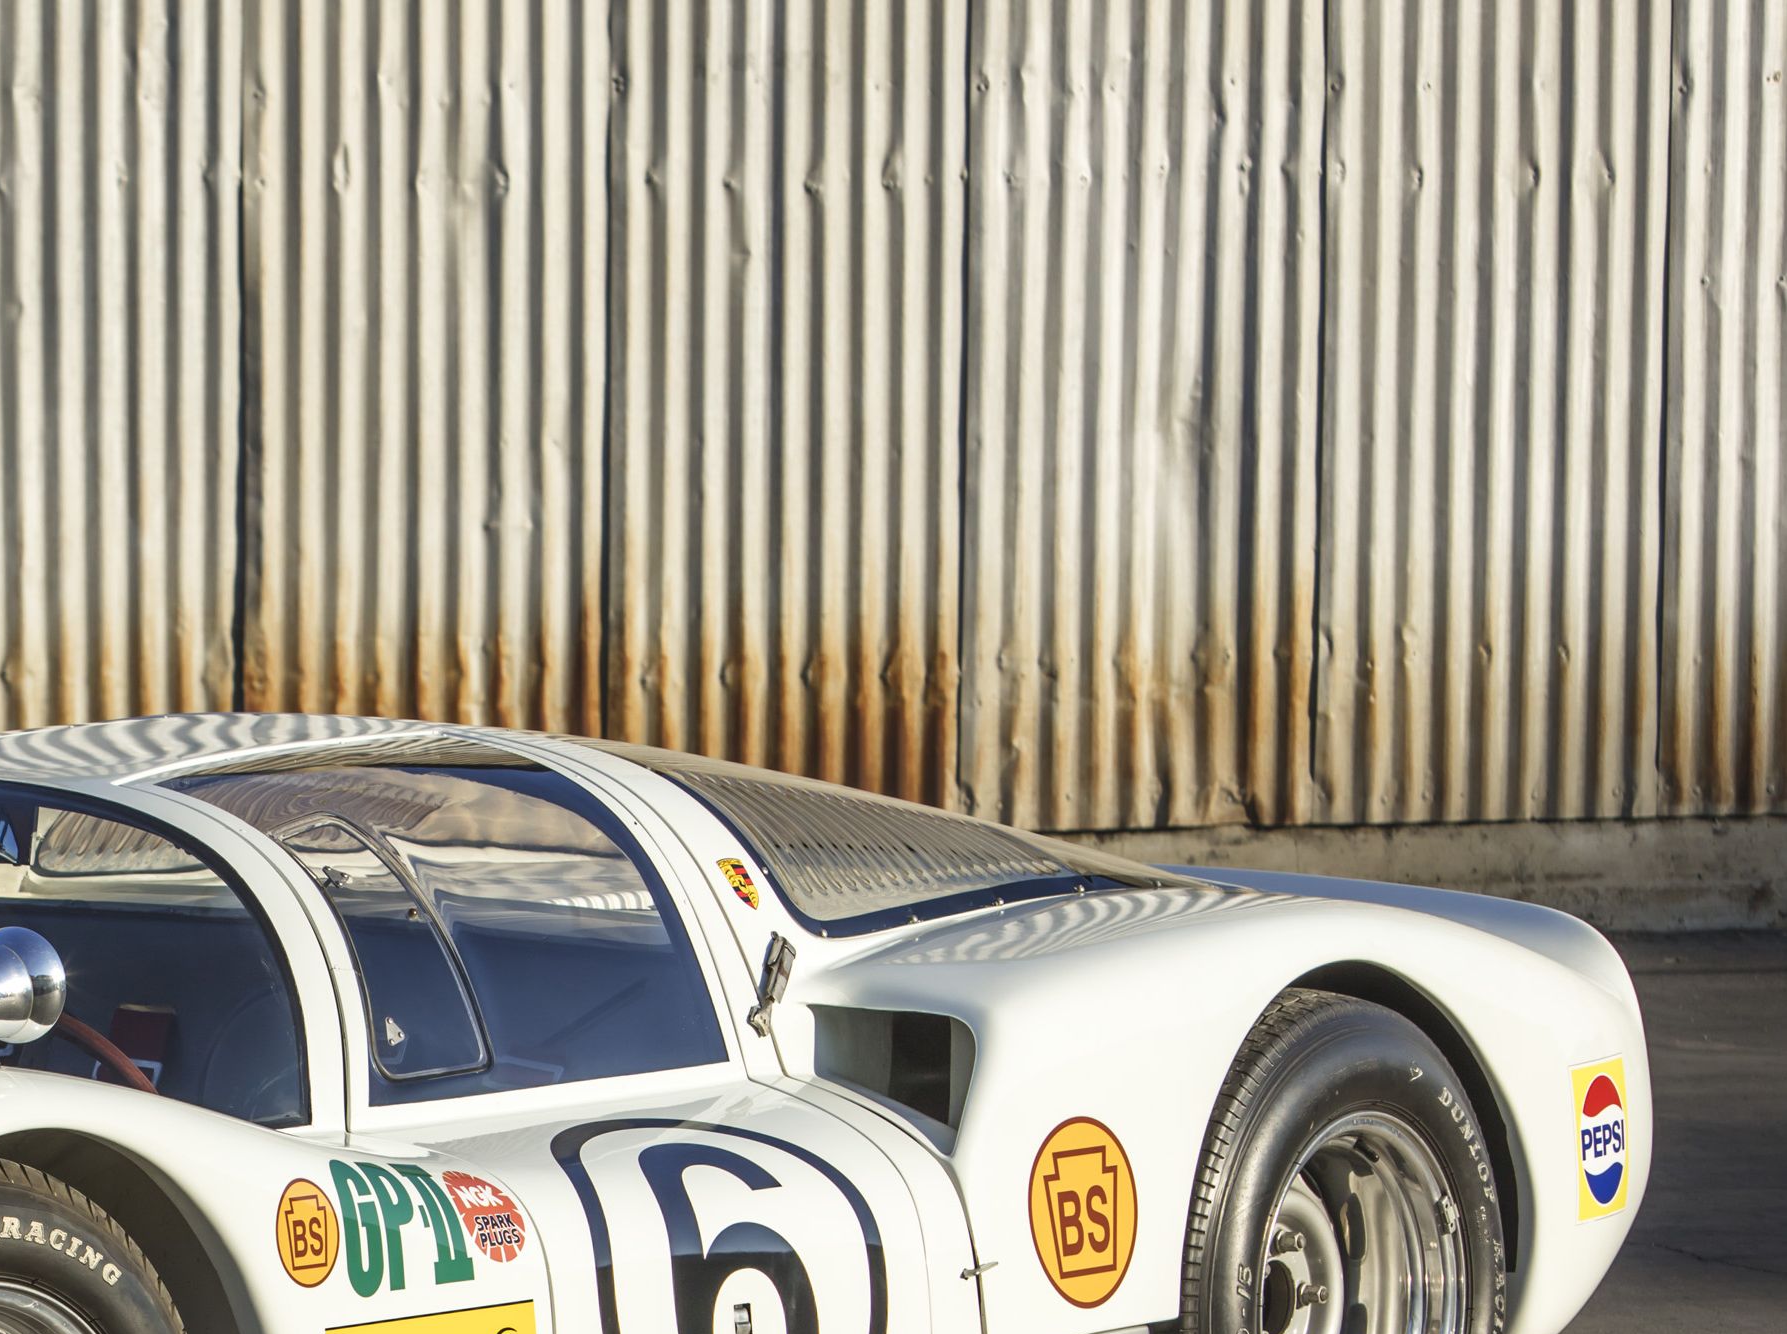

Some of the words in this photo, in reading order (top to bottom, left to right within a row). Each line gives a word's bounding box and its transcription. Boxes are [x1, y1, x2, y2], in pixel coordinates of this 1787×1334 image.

[1581, 1119, 1625, 1161] PEPSI
[452, 1184, 504, 1209] NGK
[292, 1216, 324, 1258] BS
[474, 1213, 515, 1231] SPARK
[479, 1228, 521, 1248] PLUGS
[1057, 1184, 1111, 1257] BS
[0, 1215, 122, 1286] RACING
